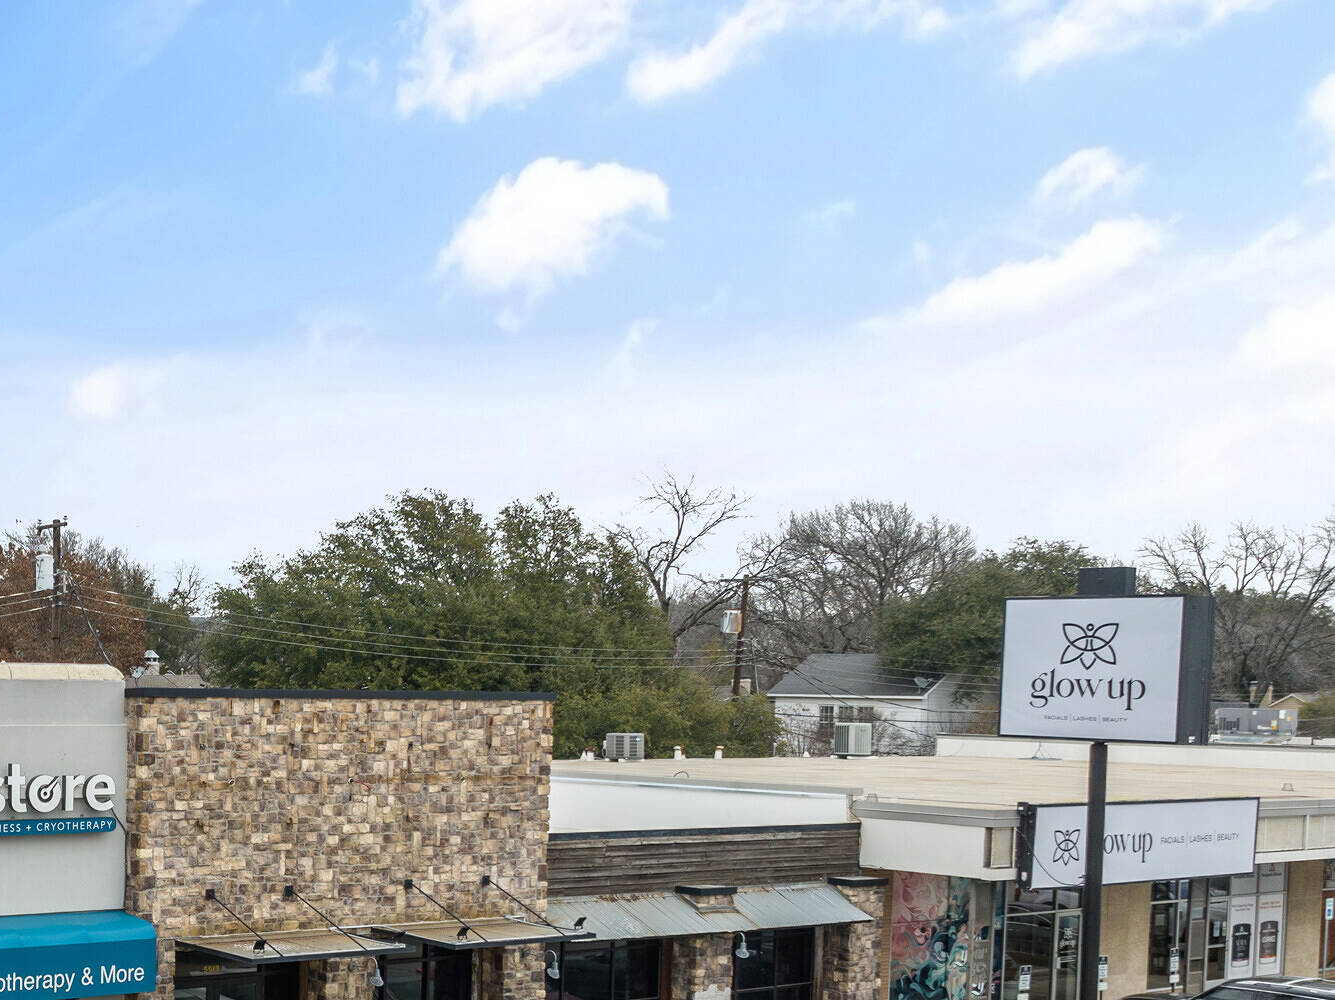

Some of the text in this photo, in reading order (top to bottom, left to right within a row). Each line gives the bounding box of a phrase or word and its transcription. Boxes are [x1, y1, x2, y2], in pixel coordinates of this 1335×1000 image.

[1029, 668, 1146, 711] glow up
[36, 820, 113, 832] CRYOTHERAPY
[1132, 832, 1153, 863] up
[1160, 832, 1239, 844] FACIALS LASHES BEAUTY
[81, 967, 94, 986] &
[100, 965, 145, 984] More
